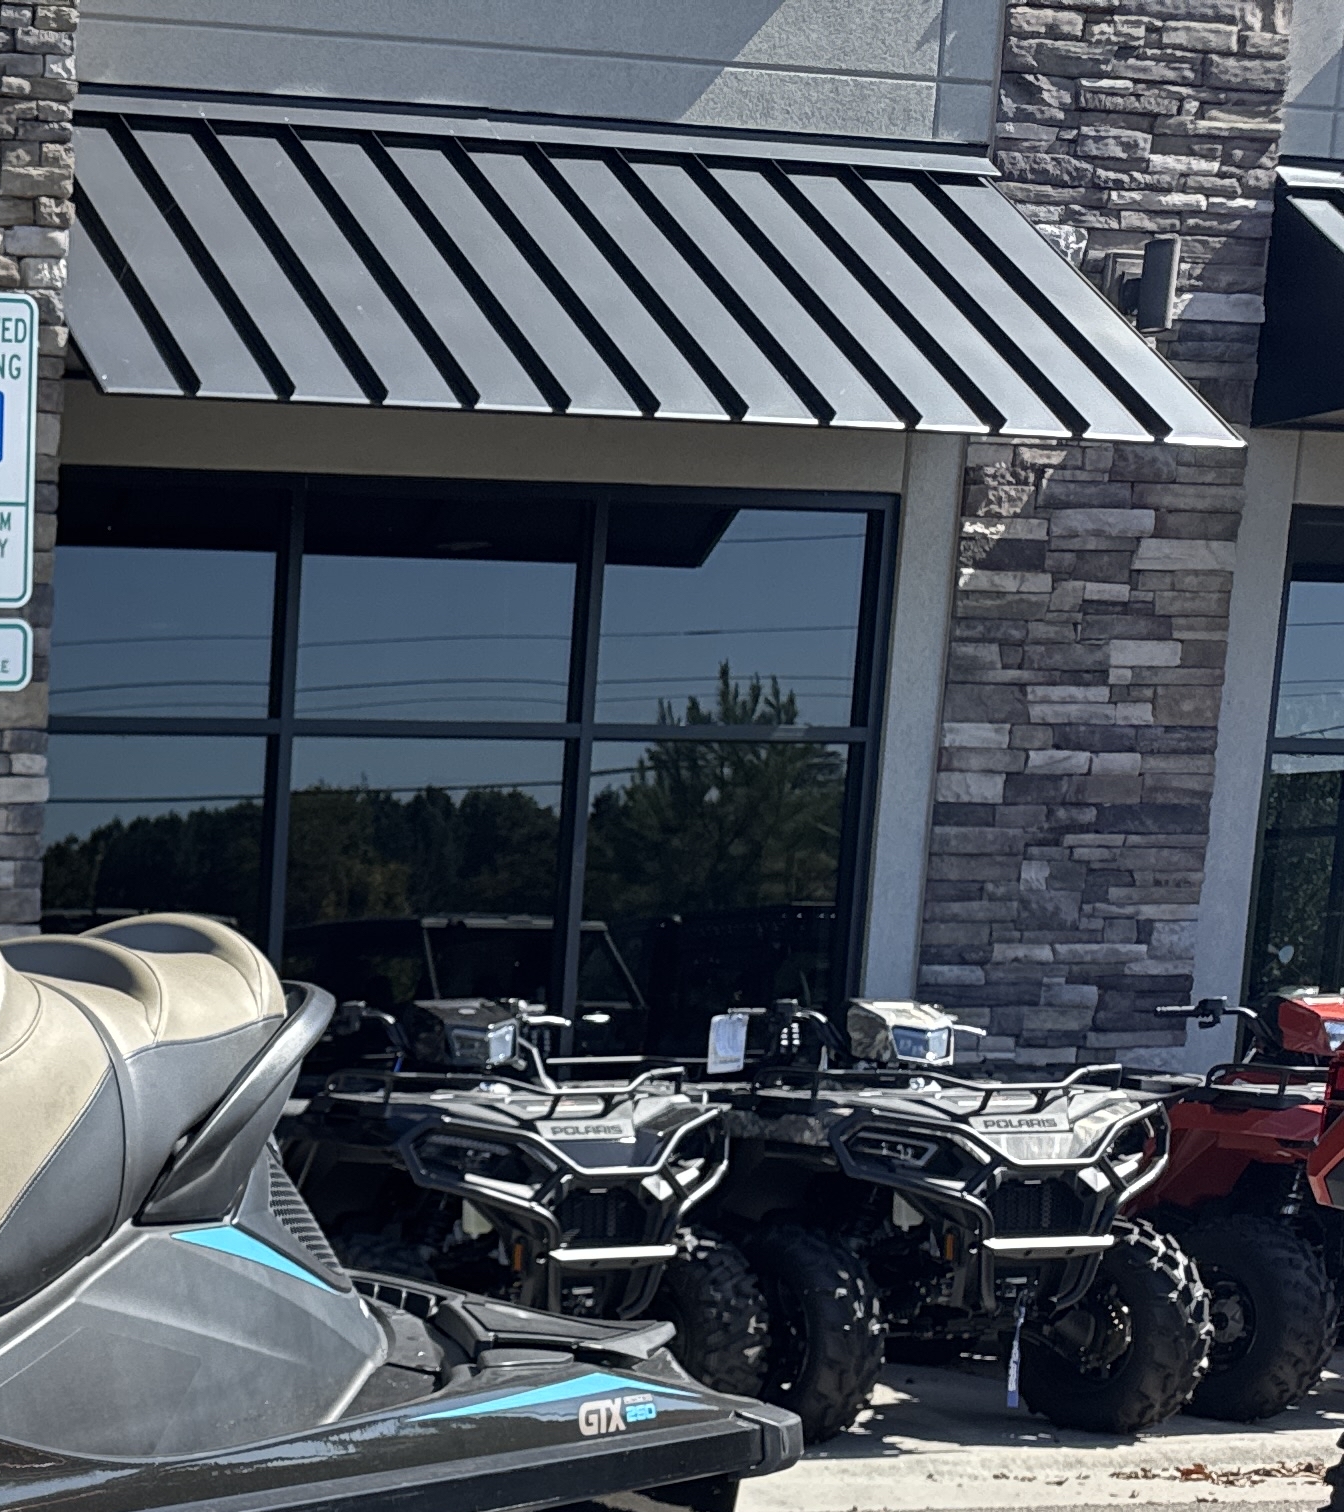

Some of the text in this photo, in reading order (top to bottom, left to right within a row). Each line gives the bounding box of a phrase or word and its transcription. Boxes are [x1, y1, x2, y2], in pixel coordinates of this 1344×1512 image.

[983, 1118, 1058, 1129] POLARIS
[551, 1124, 623, 1136] POLARIS
[579, 1397, 627, 1436] GTX
